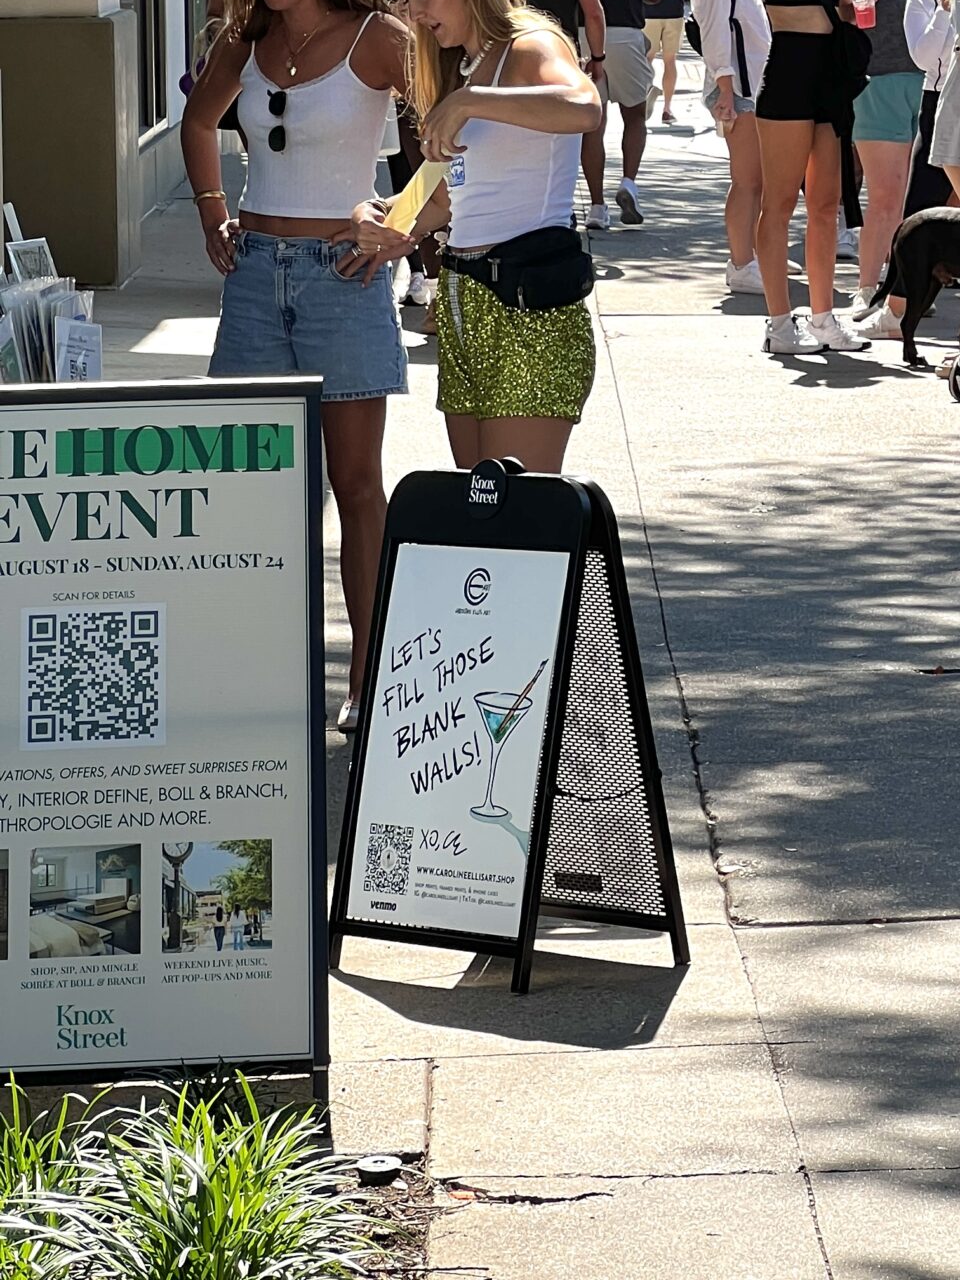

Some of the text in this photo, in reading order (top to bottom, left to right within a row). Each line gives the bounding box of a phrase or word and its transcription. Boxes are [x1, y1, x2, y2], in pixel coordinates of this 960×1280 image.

[0, 423, 282, 480] E HOME
[470, 474, 496, 491] Knox
[468, 488, 498, 505] Street
[73, 557, 90, 574] 18
[106, 554, 185, 573] SUNDAY,
[188, 552, 264, 571] AUGUST
[265, 555, 285, 571] 24
[52, 589, 136, 602] SCAN FOR DETAILS
[390, 627, 442, 673] LET'S
[382, 636, 495, 717] FILL THOSE
[392, 696, 466, 759] BLANK
[59, 765, 107, 780] OFFERS,
[111, 765, 142, 778] AND
[144, 763, 187, 777] SWEET
[188, 760, 250, 775] SURPRISES
[251, 759, 289, 772] FROM
[409, 730, 482, 795] WALLS!
[18, 791, 89, 808] INTERIOR
[94, 788, 153, 805] DEFINE,
[158, 786, 196, 802] BOLL
[199, 785, 212, 801] &
[216, 783, 289, 801] BRANCH,
[117, 812, 156, 829] AND
[159, 809, 213, 827] MORE.
[416, 865, 516, 885] WWW.CAROLINEELLISART.SHOP
[370, 899, 397, 912] venmo
[30, 963, 140, 977] SHOP, SIP, AND MINGLE
[164, 957, 268, 970] WEEKEND LIVE MUSIC,
[55, 978, 69, 989] AT
[70, 977, 95, 988] BOLL
[96, 977, 105, 987] &
[107, 976, 146, 987] BRANCH
[161, 970, 273, 984] ART POP-UPS AND MORE
[56, 1004, 115, 1026] Knox
[56, 1027, 128, 1050] Street
